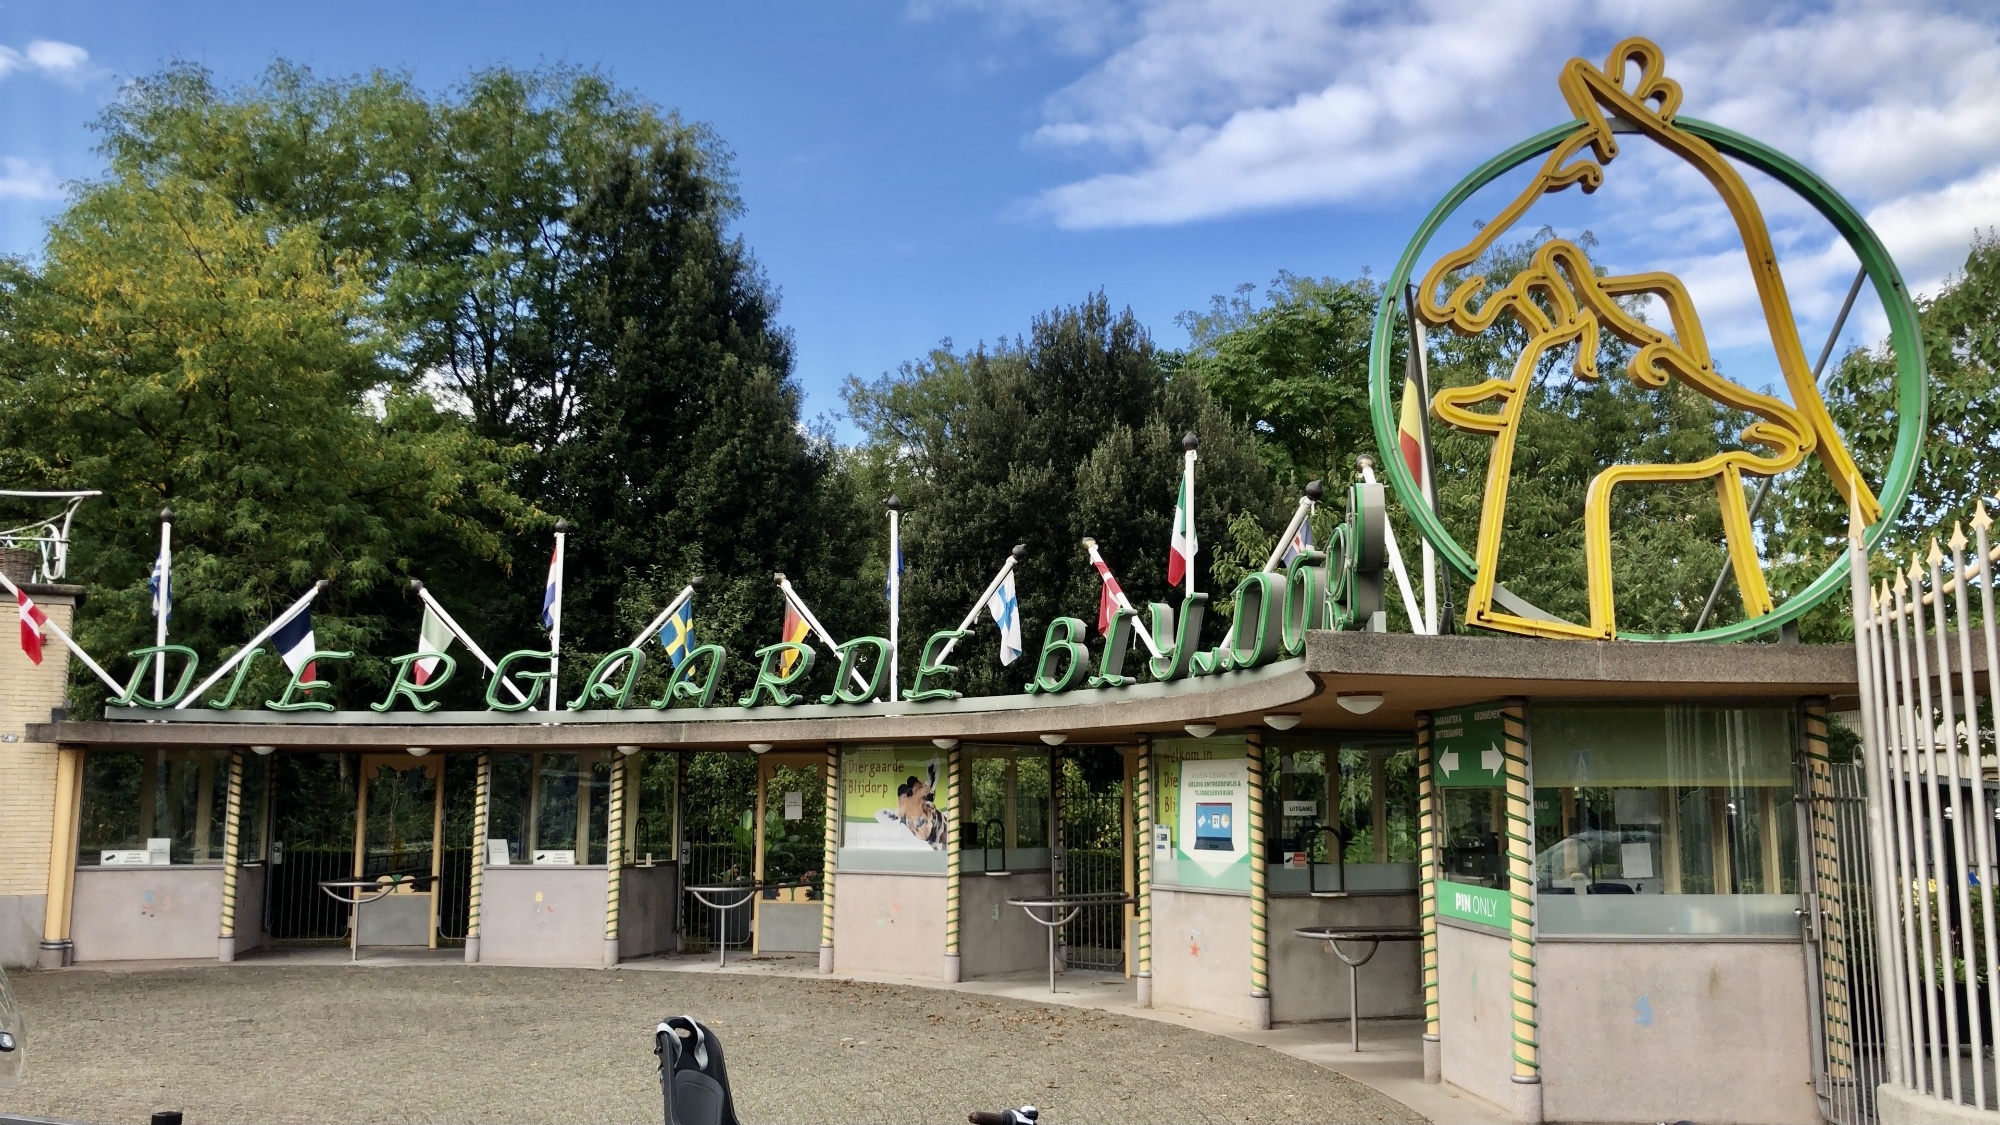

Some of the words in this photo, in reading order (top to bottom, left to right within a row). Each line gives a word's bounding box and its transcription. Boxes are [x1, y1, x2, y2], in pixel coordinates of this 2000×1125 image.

[105, 629, 977, 713] DIERGAARDE
[848, 759, 904, 777] Diergaarde
[848, 779, 888, 798] Blijdorp
[1533, 800, 1550, 810] ANG
[1455, 892, 1472, 913] PIN
[1472, 895, 1498, 918] ONLY
